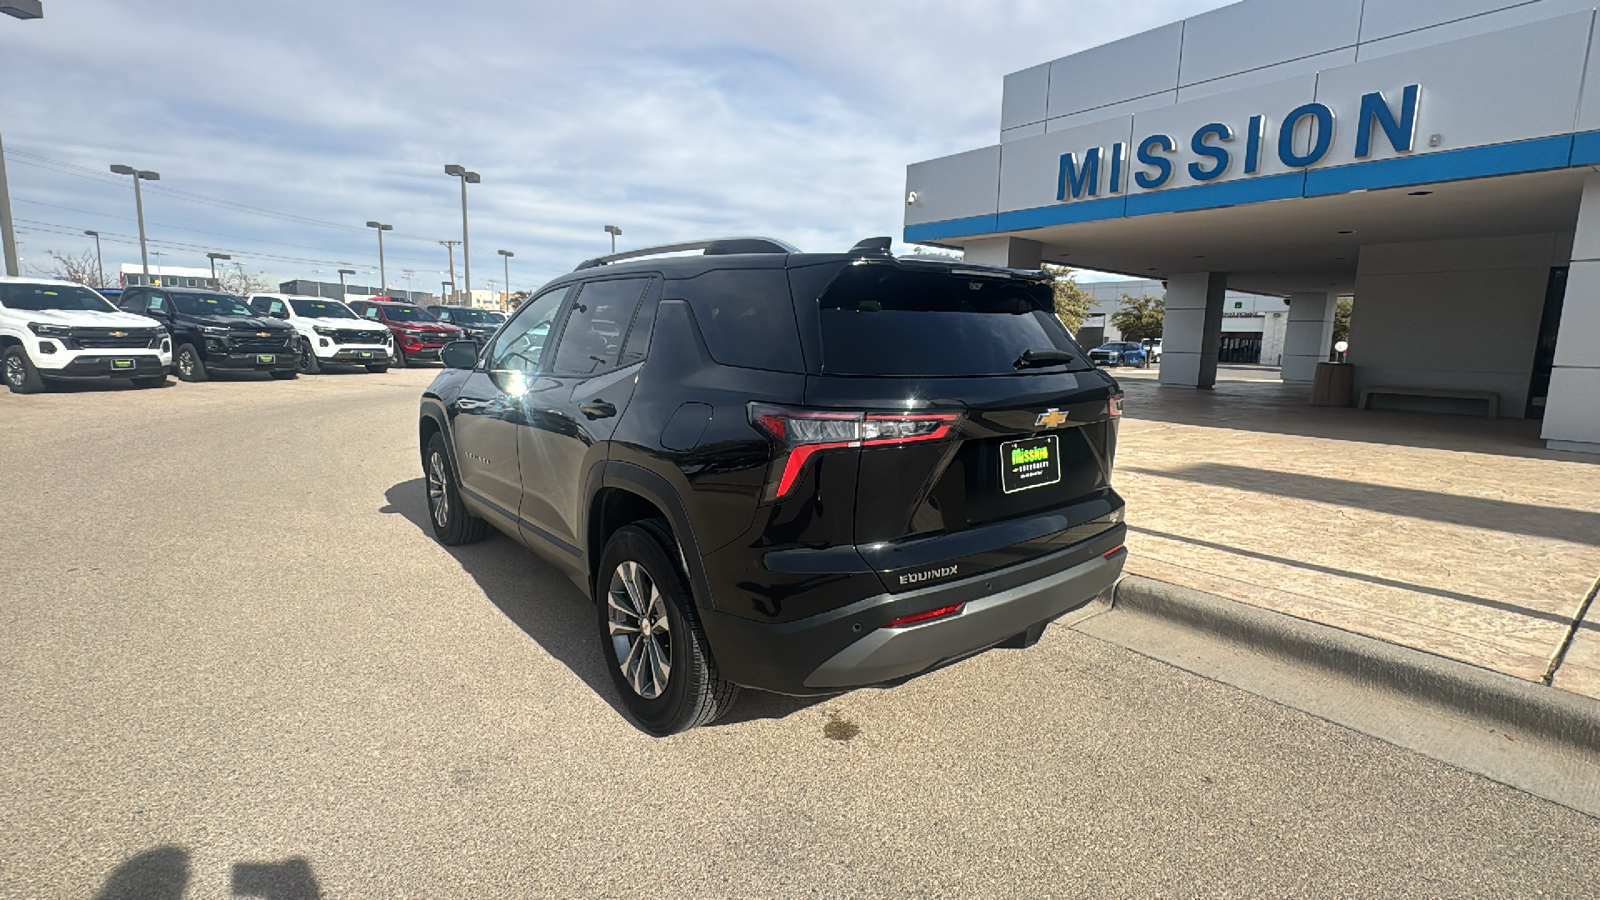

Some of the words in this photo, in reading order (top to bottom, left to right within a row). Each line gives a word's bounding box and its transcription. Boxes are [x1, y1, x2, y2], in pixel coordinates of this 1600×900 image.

[1057, 84, 1421, 200] MISSION
[1012, 446, 1048, 465] Mission
[899, 564, 958, 585] EQUINOX
